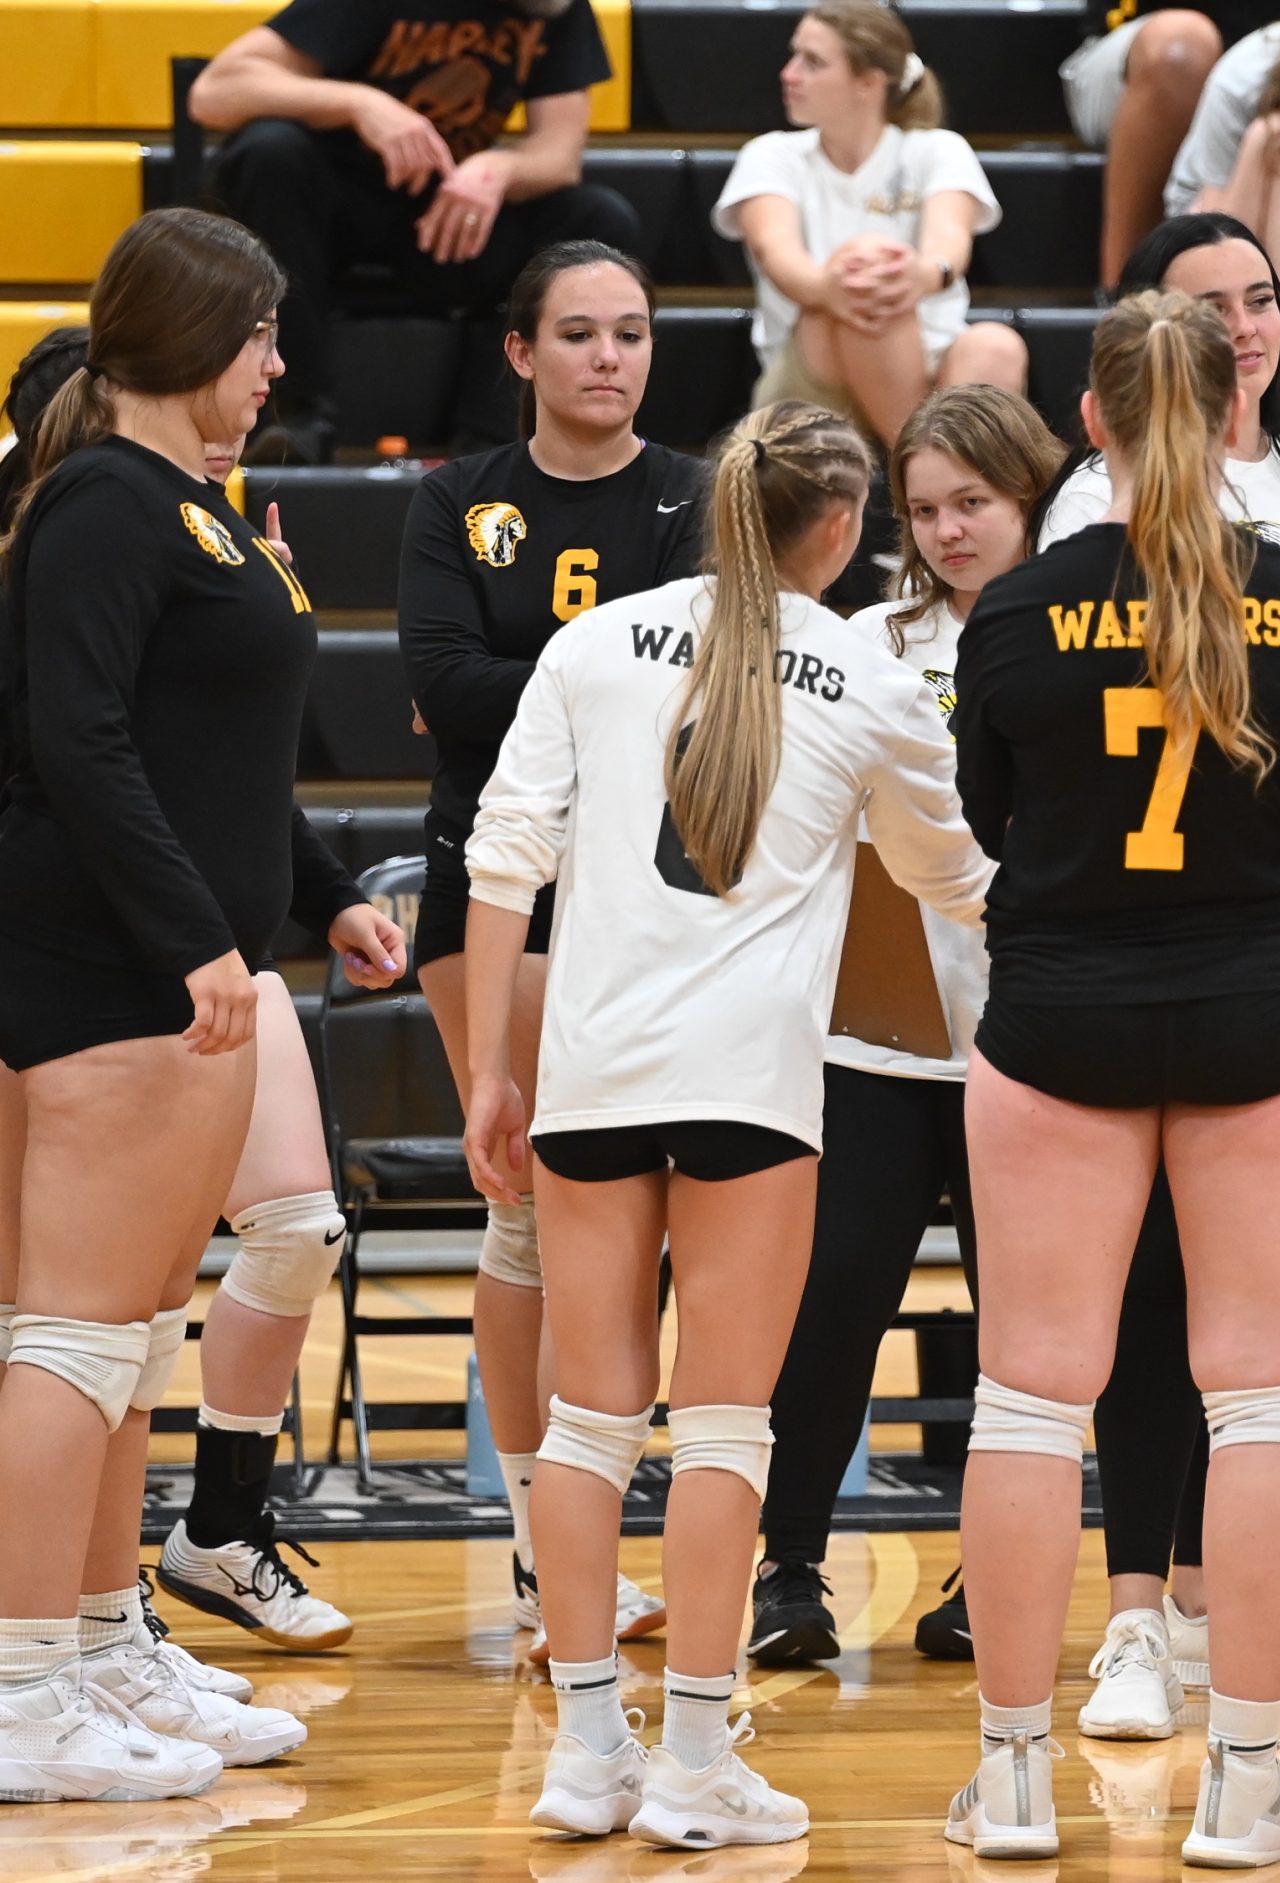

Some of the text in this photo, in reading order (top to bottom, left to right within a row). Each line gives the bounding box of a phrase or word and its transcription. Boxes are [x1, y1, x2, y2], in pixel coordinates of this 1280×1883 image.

[552, 548, 600, 622] 6
[631, 623, 846, 702] WAORS
[1104, 687, 1205, 870] 7
